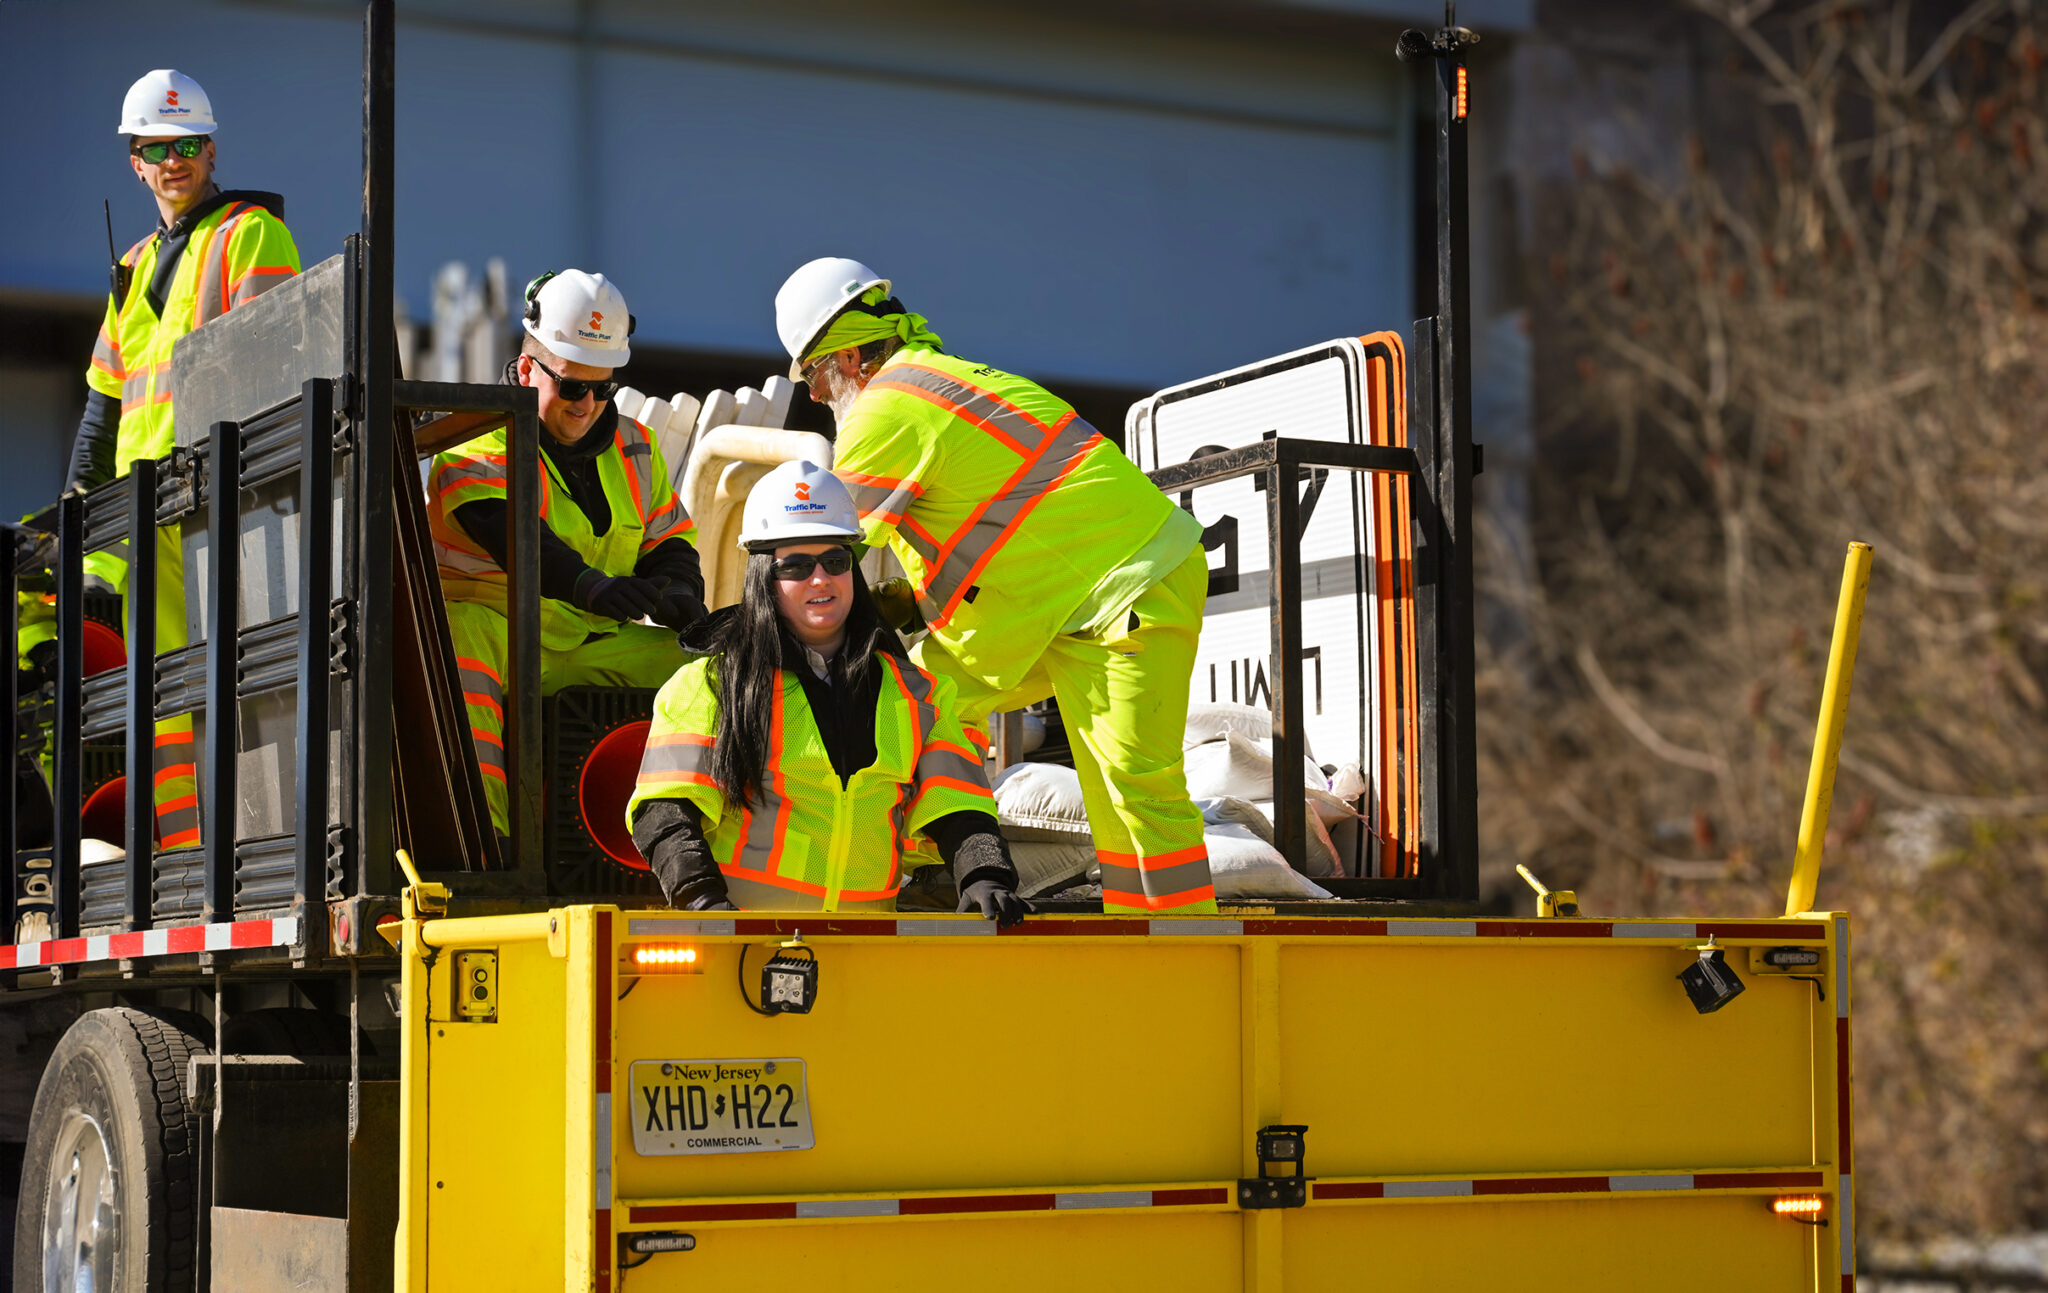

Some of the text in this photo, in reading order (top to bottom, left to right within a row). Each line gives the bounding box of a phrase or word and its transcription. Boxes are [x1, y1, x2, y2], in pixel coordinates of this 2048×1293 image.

[578, 330, 598, 339] Traffic
[784, 504, 808, 512] Traffic
[674, 1065, 762, 1082] New Jersey
[642, 1084, 798, 1131] XHD H22
[687, 1137, 762, 1148] COMMERCIAL
